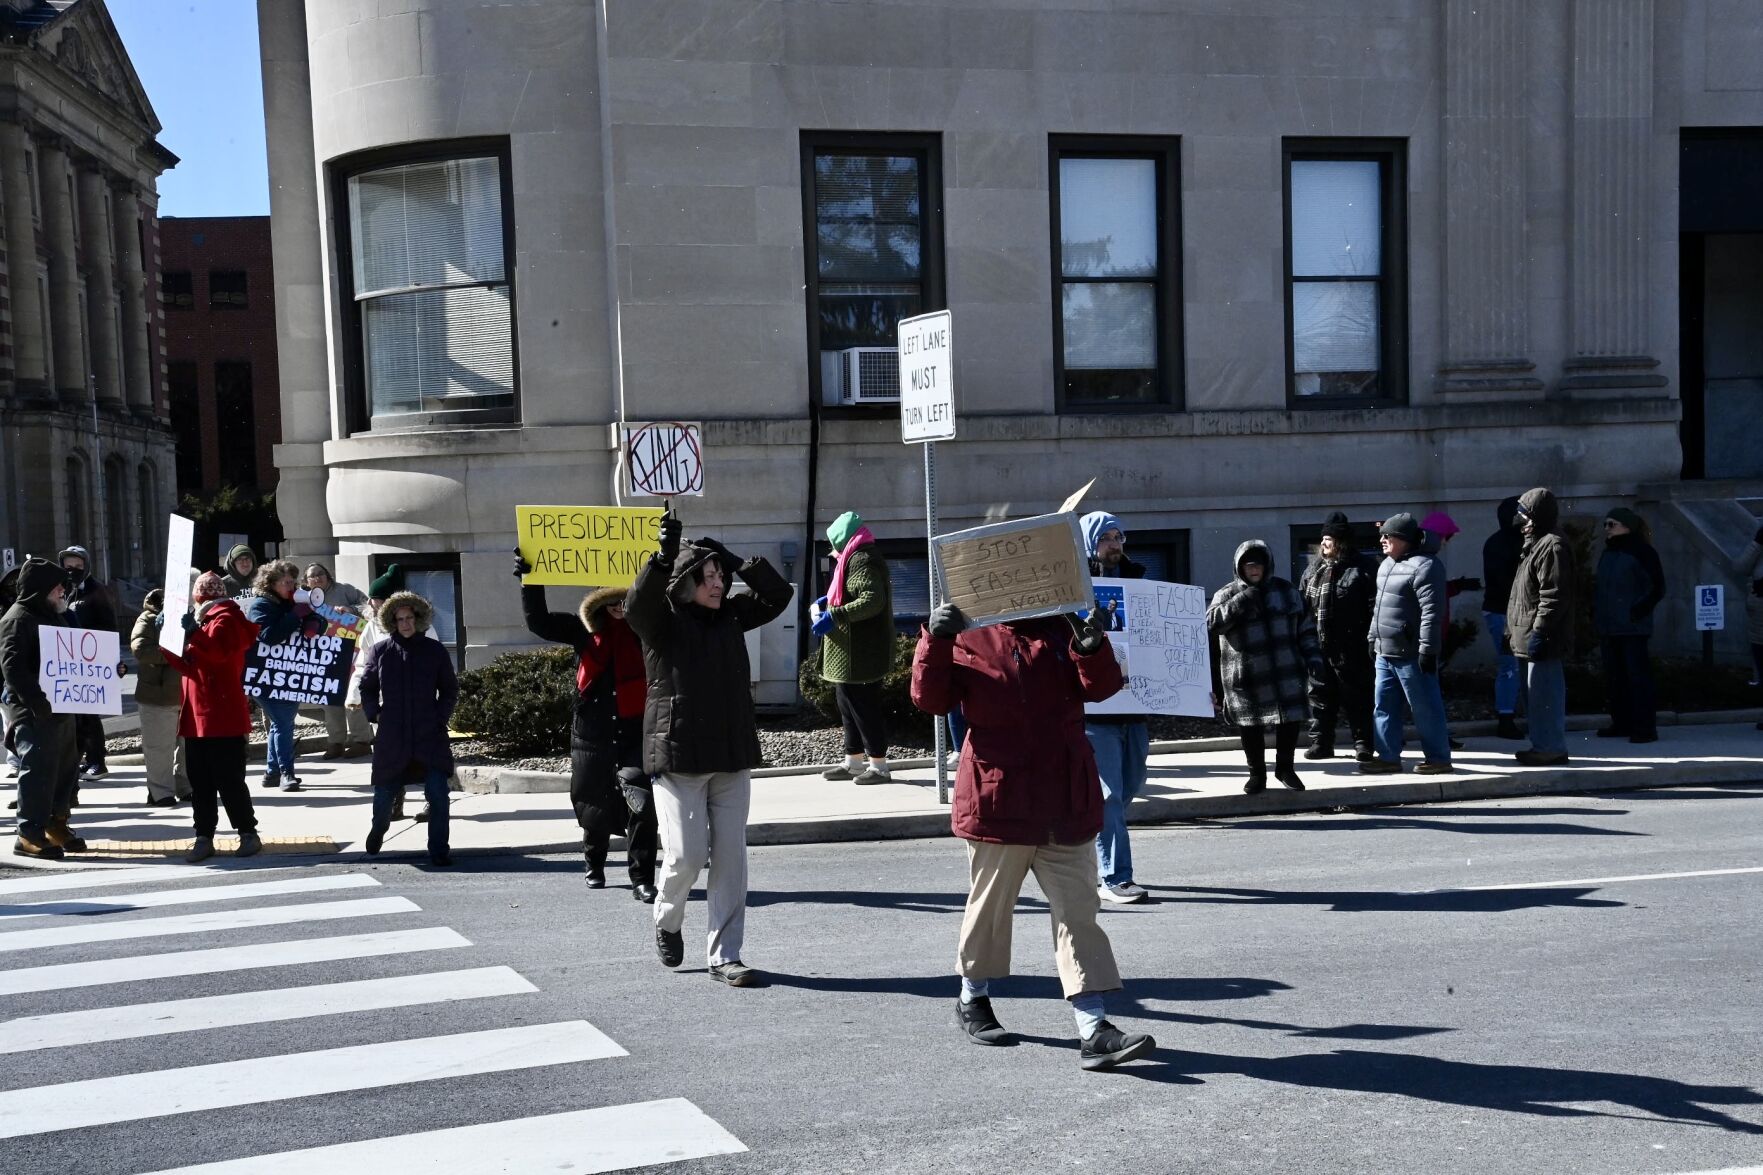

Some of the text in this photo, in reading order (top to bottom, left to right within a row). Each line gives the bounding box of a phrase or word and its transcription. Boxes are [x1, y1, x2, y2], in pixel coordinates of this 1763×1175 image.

[903, 330, 946, 355] LEFT LANE
[911, 366, 936, 391] MUST
[905, 403, 949, 425] TURN LEFT
[626, 424, 704, 493] KINGS
[529, 513, 661, 542] PRESIDENTS
[534, 547, 601, 574] AREN'T
[977, 535, 1032, 561] STOP
[969, 559, 1068, 599] FASCISM
[1156, 585, 1205, 616] FASCIST
[56, 630, 98, 662] NO
[1163, 621, 1207, 647] FREAKS
[257, 641, 338, 666] DONALD:
[244, 667, 340, 694] FASCISM
[264, 658, 326, 677] BRINGING
[243, 685, 329, 706] TO AMERICA
